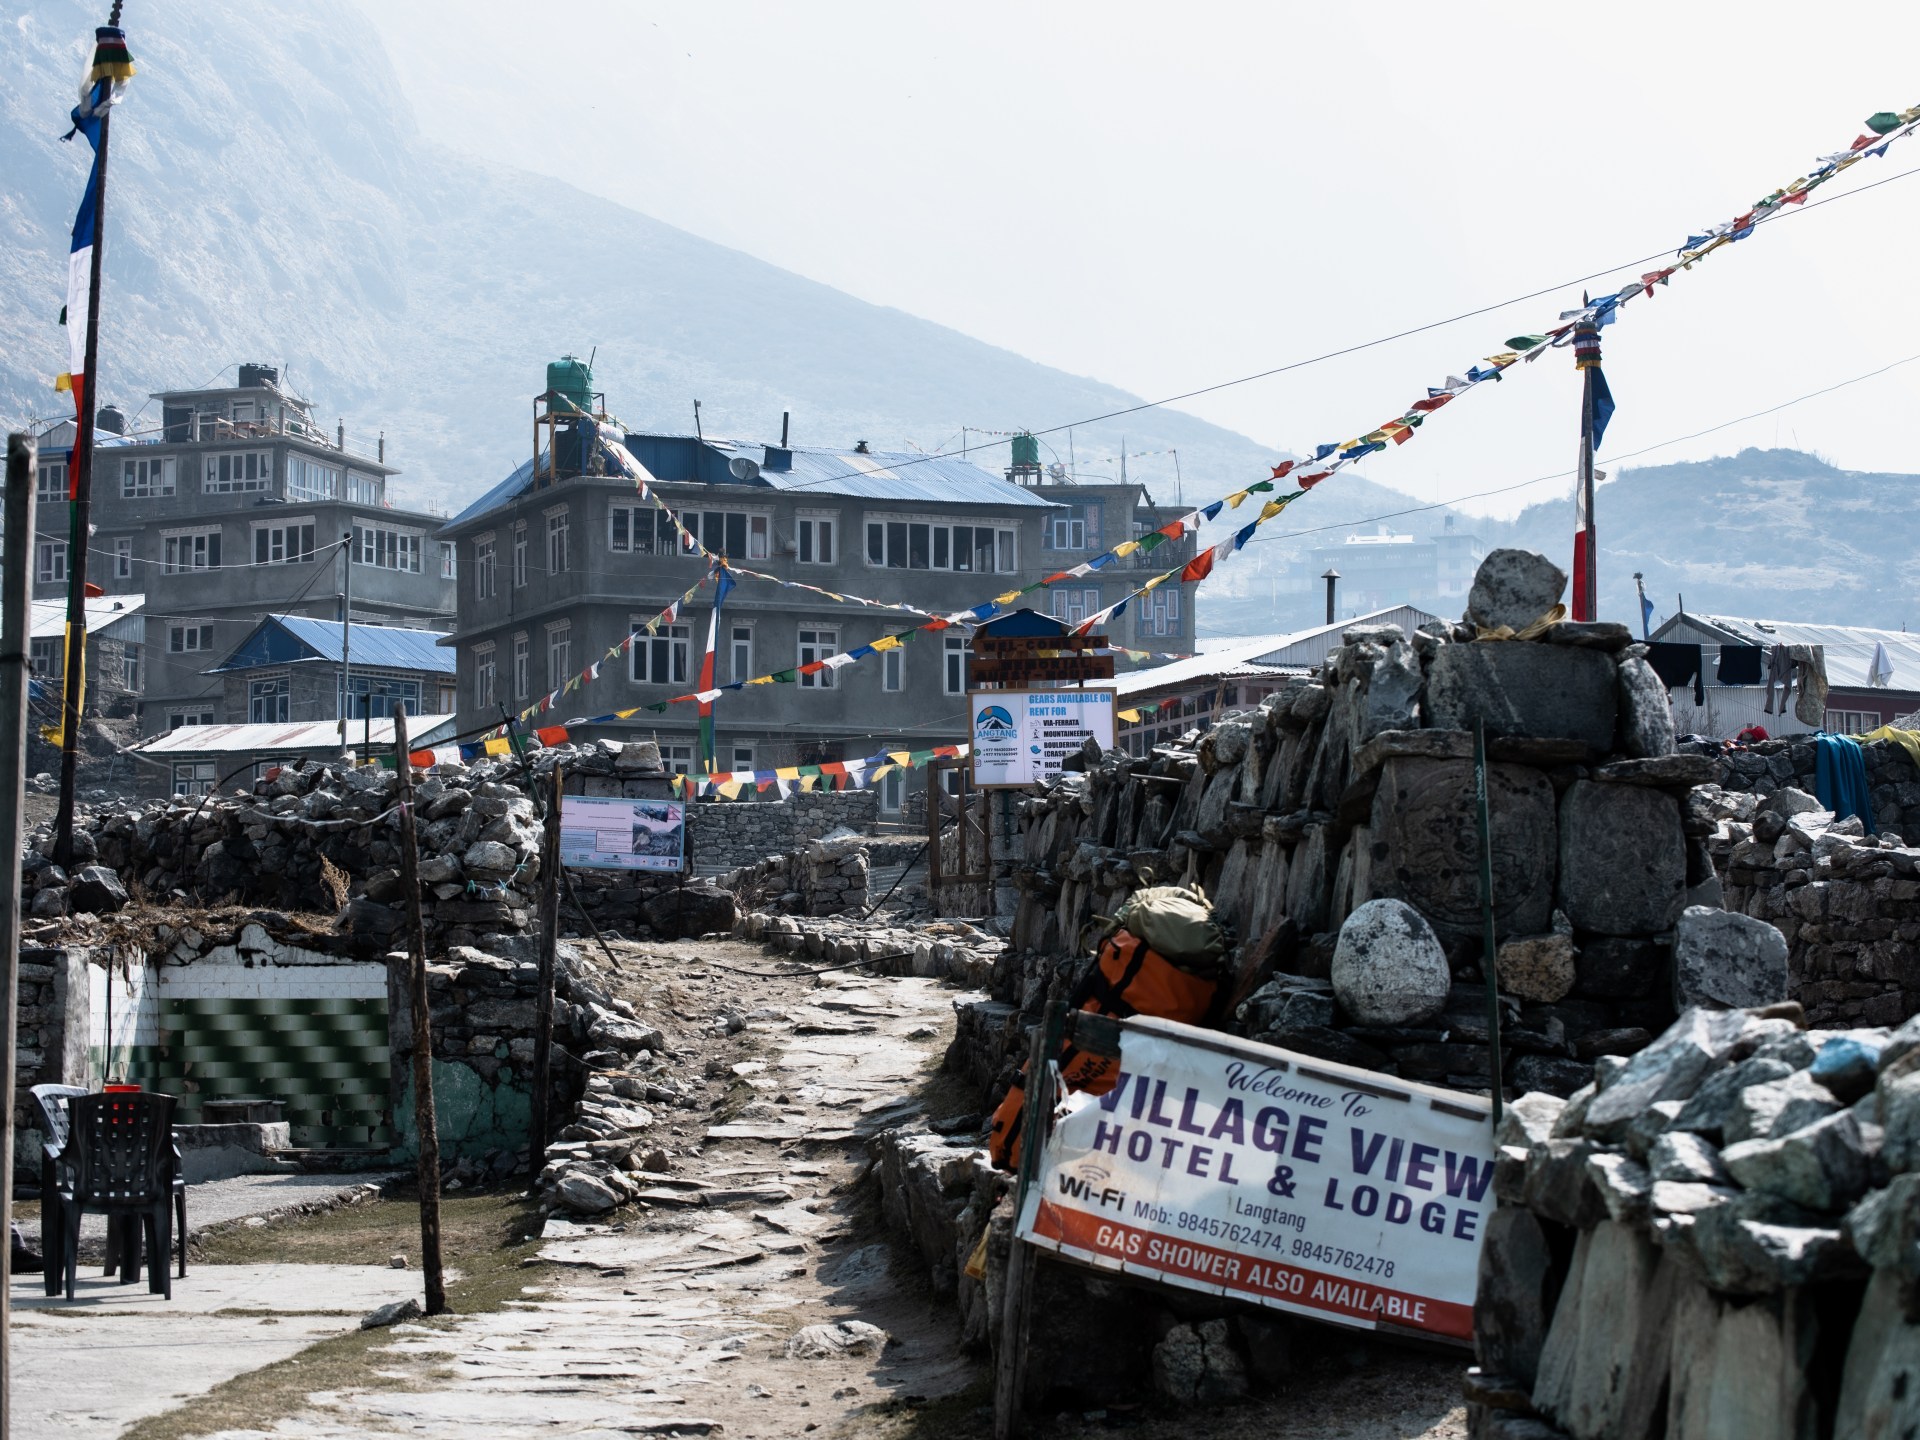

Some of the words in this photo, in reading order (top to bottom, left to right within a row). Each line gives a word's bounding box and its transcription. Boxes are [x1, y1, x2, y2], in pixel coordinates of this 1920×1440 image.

[1081, 638, 1103, 649] TO
[1029, 694, 1055, 704] GEARS
[1057, 693, 1099, 703] AVAILABLE
[1100, 693, 1111, 702] ON
[1029, 707, 1049, 716] RENT
[1051, 706, 1067, 716] FOR
[1043, 719, 1080, 727] VIA-FERRATA
[1043, 730, 1094, 738] MOUNTAINEERING
[1043, 741, 1080, 749] BOULDERING
[1044, 761, 1061, 769] ROCK
[1225, 1061, 1336, 1109] Welcome
[1341, 1091, 1379, 1118] To
[1101, 1071, 1328, 1164] VILLAGE
[1350, 1126, 1495, 1203] VIEW
[1059, 1173, 1127, 1212] Wi-Fi
[1093, 1120, 1239, 1186] HOTEL
[1266, 1164, 1297, 1199] &
[1323, 1177, 1480, 1242] LODGE
[1235, 1196, 1306, 1233] Langtang
[1133, 1200, 1173, 1226] Mob:
[1177, 1211, 1286, 1256] 9845762474,
[1291, 1238, 1396, 1279] 9845762478
[1096, 1224, 1142, 1255] GAS
[1146, 1238, 1242, 1281] SHOWER
[1246, 1264, 1305, 1296] ALSO
[1310, 1279, 1427, 1324] AVAILABLE
